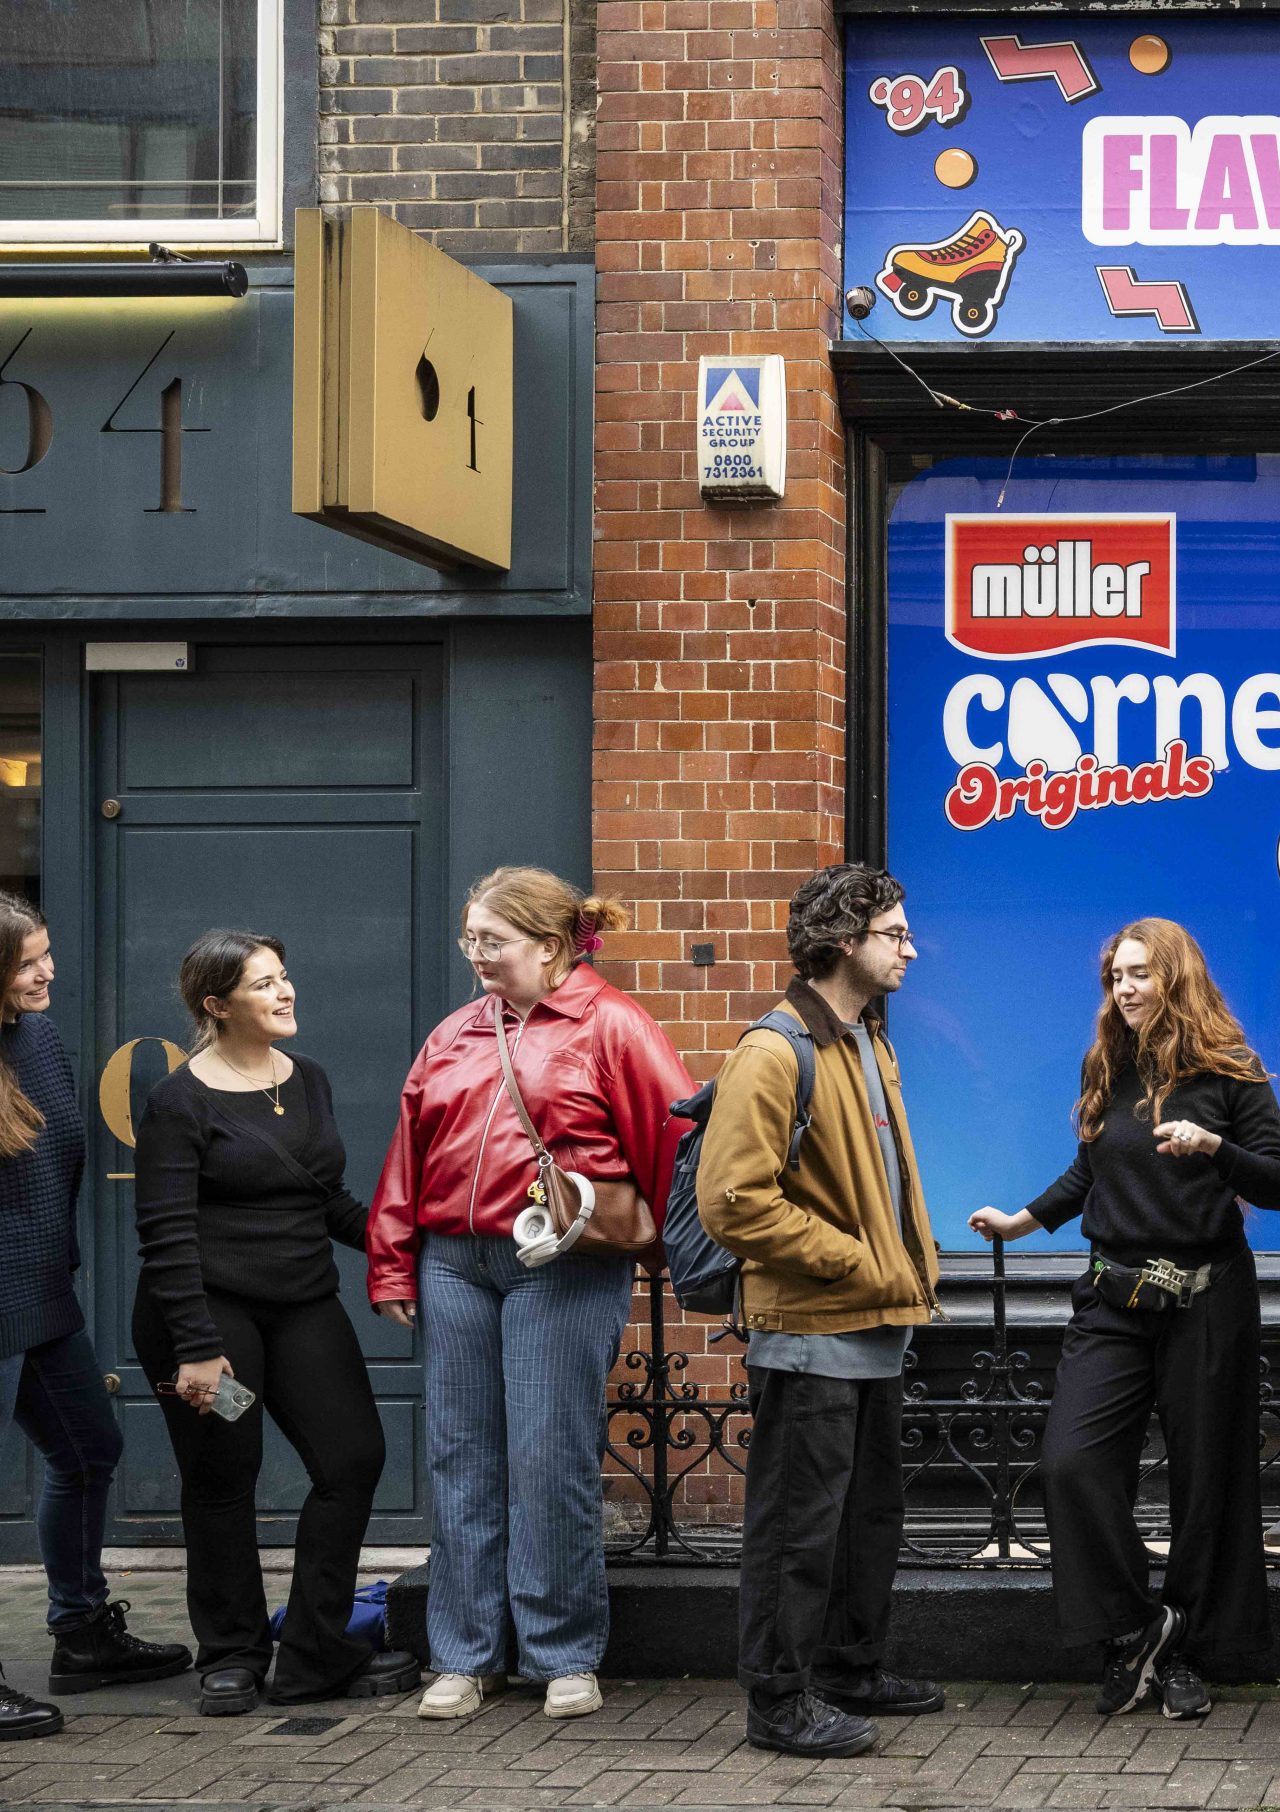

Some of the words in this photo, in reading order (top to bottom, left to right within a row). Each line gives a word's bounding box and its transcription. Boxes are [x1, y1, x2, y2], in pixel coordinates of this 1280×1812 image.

[703, 416, 762, 426] ACTIVE
[703, 428, 761, 437] SECURITY
[709, 439, 755, 448] GROUP
[714, 455, 752, 466] 0800
[704, 466, 763, 479] 7312361
[970, 539, 1151, 618] müller
[946, 741, 1212, 829] Originals
